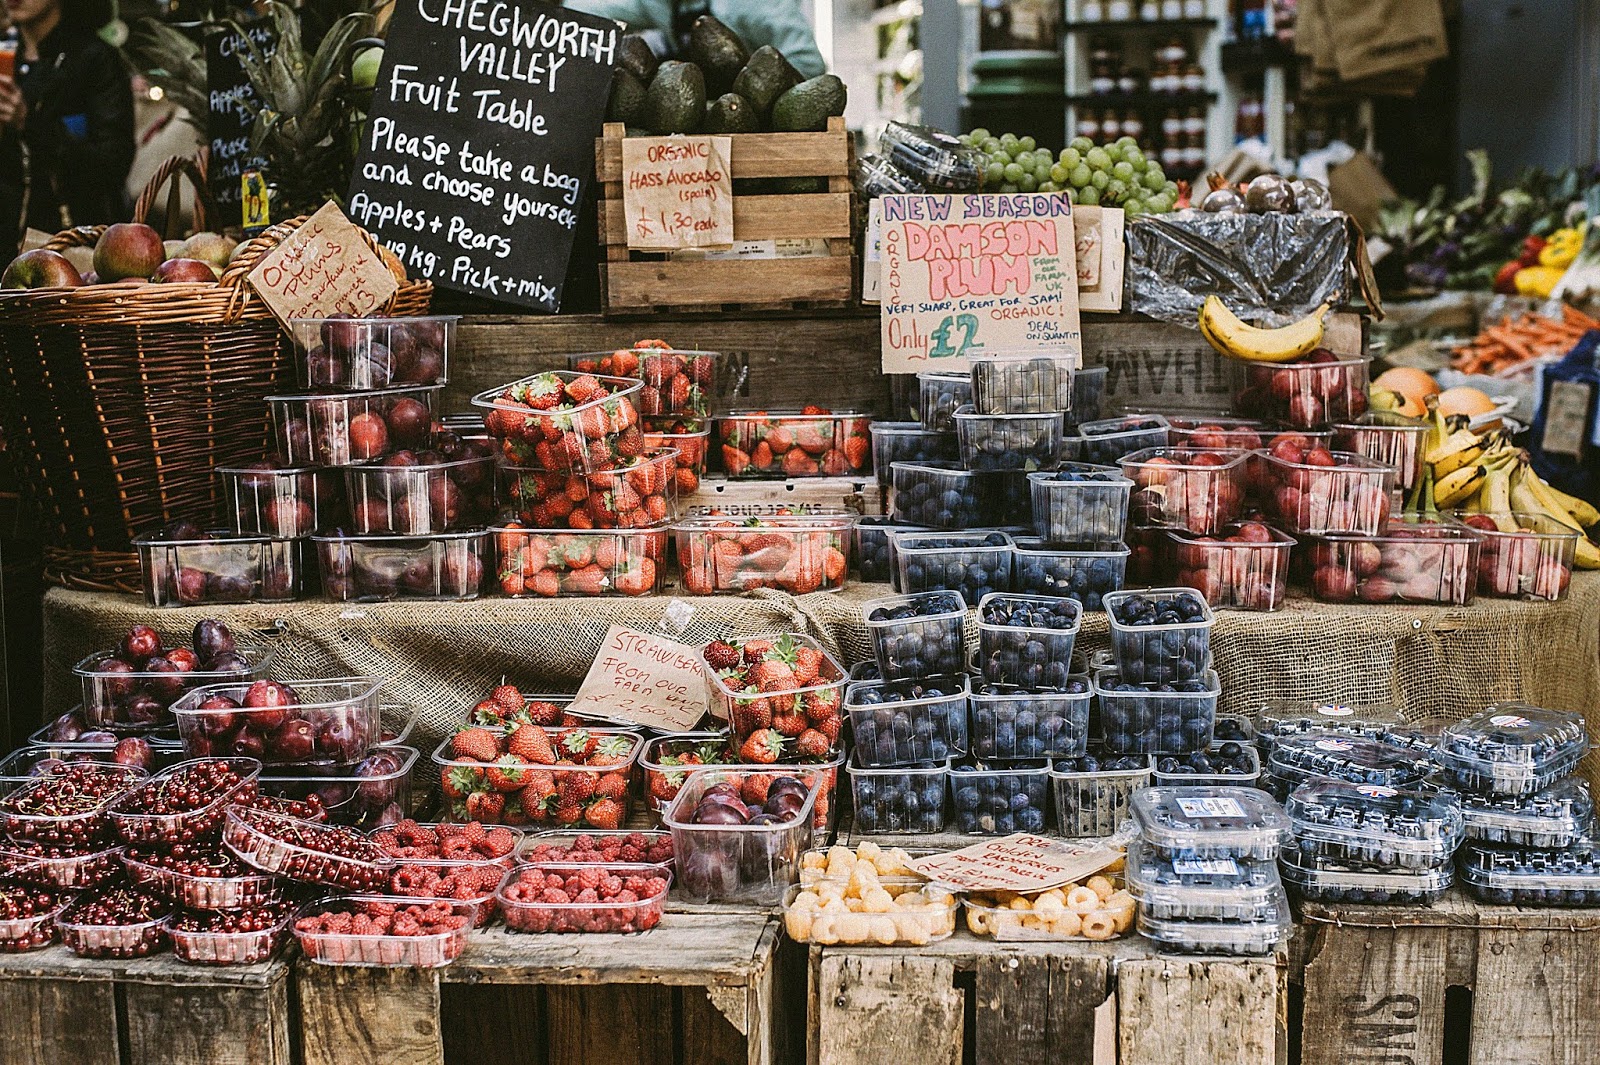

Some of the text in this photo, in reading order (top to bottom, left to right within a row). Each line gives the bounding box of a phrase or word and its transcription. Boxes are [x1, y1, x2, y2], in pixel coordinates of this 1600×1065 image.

[418, 0, 616, 65] CHEGWORTH
[459, 36, 566, 92] VALLEY
[390, 65, 548, 136] Fruit Table
[371, 117, 580, 204] Please take a bag
[648, 143, 709, 163] ORGANIC
[363, 162, 577, 229] and choose yourself
[629, 169, 722, 190] HASS AVOCADO
[350, 191, 426, 231] Apples
[447, 216, 511, 258] Pears
[694, 217, 718, 231] each
[884, 193, 1071, 221] NEW SEASON
[263, 223, 324, 288] Organic
[904, 219, 1059, 262] DAMSON
[928, 255, 1031, 301] PLUM
[1033, 257, 1060, 267] FROM
[886, 302, 915, 315] VERY
[959, 299, 995, 311] GREAT
[1000, 297, 1021, 307] FOR
[1028, 291, 1063, 306] JAM!
[1045, 281, 1063, 292] UK
[888, 313, 984, 361] Only £2
[1026, 332, 1040, 340] ON
[1027, 321, 1059, 332] DEALS
[603, 657, 688, 696] FROM OUR
[614, 677, 653, 696] FARM
